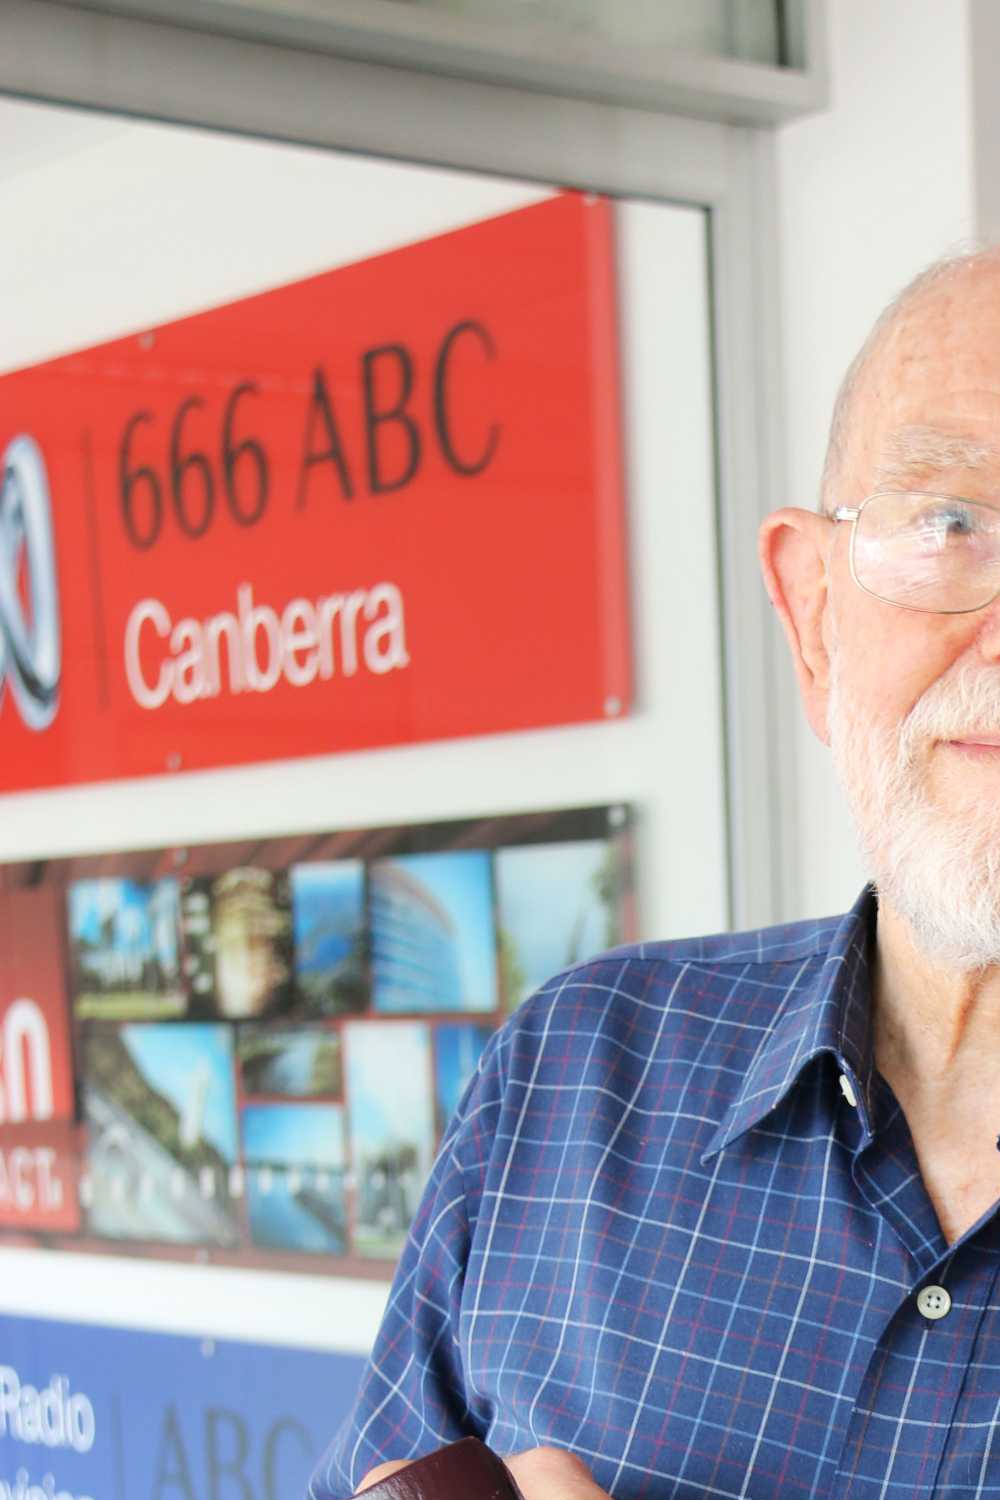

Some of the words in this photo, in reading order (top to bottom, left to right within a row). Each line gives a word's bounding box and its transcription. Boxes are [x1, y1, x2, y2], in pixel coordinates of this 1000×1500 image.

[119, 380, 270, 551] 666
[294, 319, 501, 511] ABC
[123, 582, 410, 710] Canberra
[0, 1365, 96, 1453] Radio
